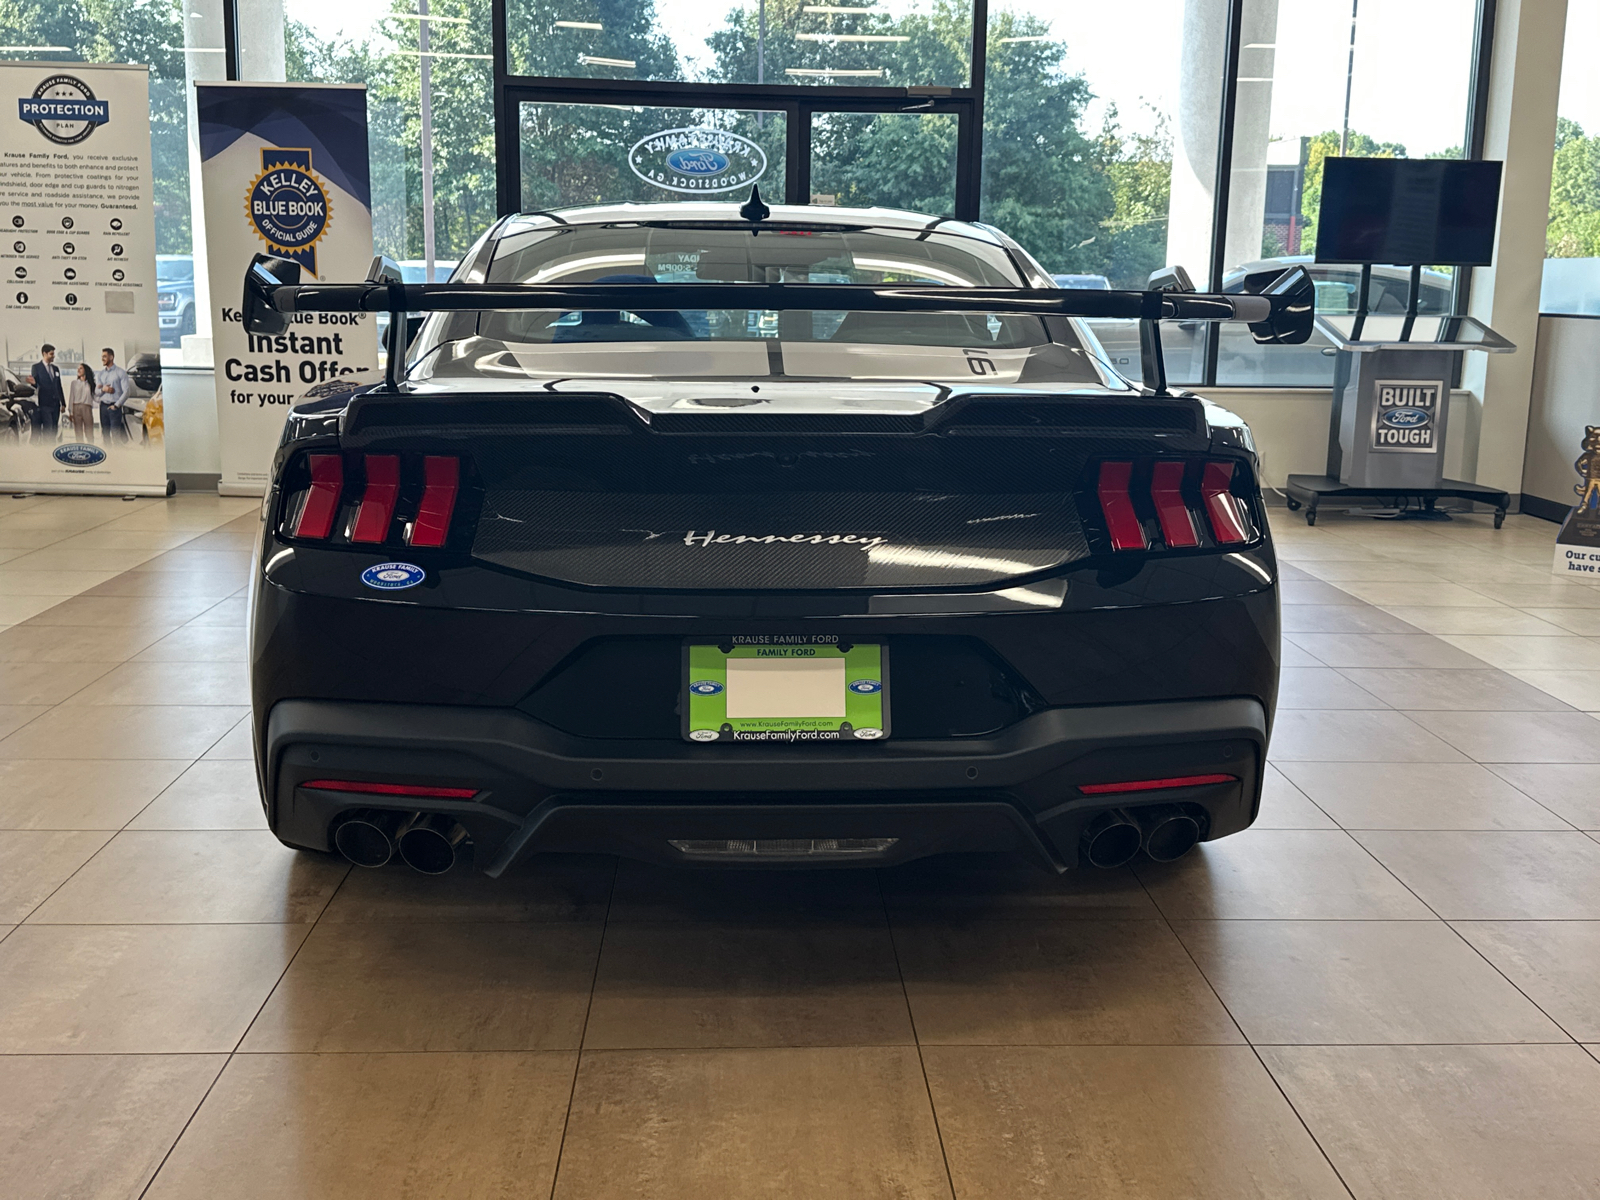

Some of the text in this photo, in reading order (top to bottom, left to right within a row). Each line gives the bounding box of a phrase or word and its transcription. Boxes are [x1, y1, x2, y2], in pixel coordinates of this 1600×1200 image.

[37, 77, 91, 97] KRAUSE FAMILY FORD
[23, 103, 104, 116] PROTECTION
[29, 152, 50, 160] Family
[260, 172, 319, 198] KELLEY
[253, 200, 324, 217] BLUE BOOK
[261, 218, 318, 242] OFFICIAL GUIDE
[290, 311, 314, 324] lue
[248, 331, 344, 356] Instant
[225, 358, 291, 384] Cash
[230, 389, 295, 408] for your
[1381, 387, 1435, 407] BUILT
[1391, 411, 1420, 423] Ford
[1378, 429, 1431, 444] TOUGH
[683, 529, 889, 551] Hennessey
[1565, 550, 1587, 560] Our
[371, 564, 419, 574] KRAUSE FAMILY
[1568, 561, 1595, 572] have
[382, 571, 403, 580] Ford
[732, 635, 839, 644] KRAUSE FAMILY FORD
[757, 648, 816, 656] FAMILY FORD
[733, 729, 840, 743] KrauseFamilyFord.com
